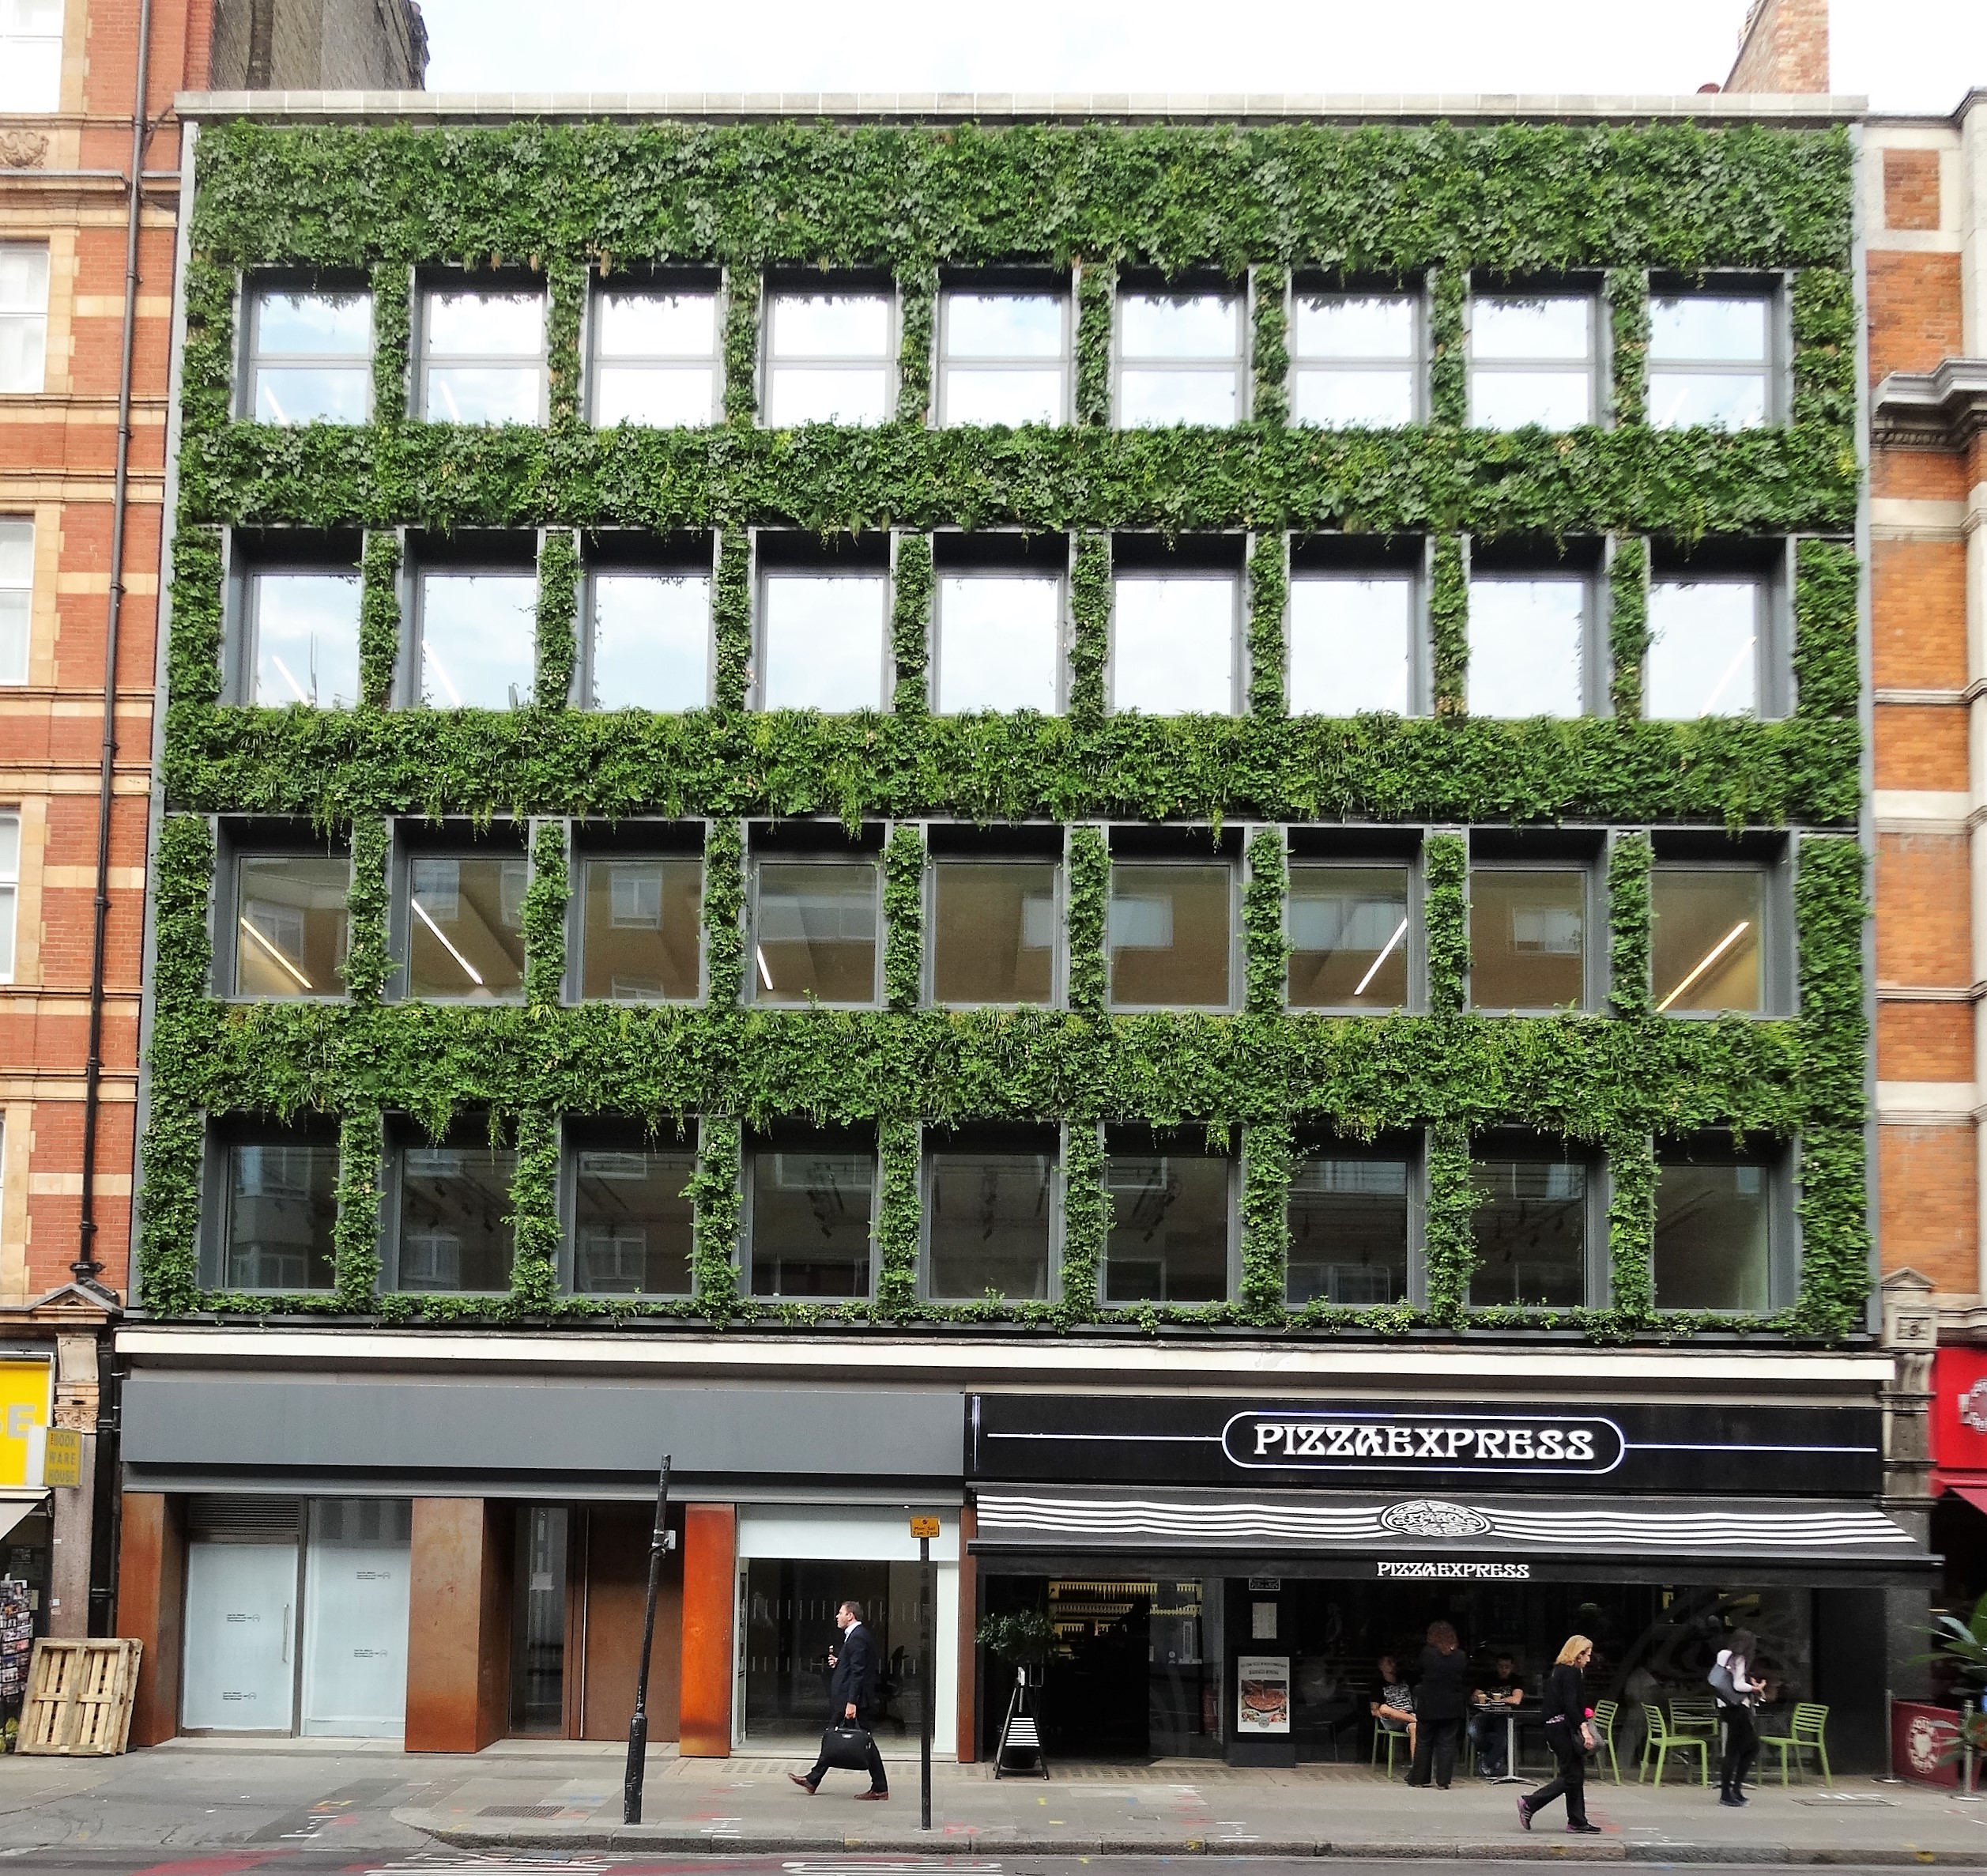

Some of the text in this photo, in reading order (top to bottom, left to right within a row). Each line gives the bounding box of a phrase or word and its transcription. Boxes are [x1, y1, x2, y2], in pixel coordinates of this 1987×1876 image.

[54, 1432, 75, 1448] BOOK
[1253, 1424, 1595, 1460] PIZZAEXPRESS
[48, 1451, 76, 1466] WARE
[47, 1470, 75, 1483] HOUSE
[1377, 1561, 1530, 1579] PIZZAEXPRESS
